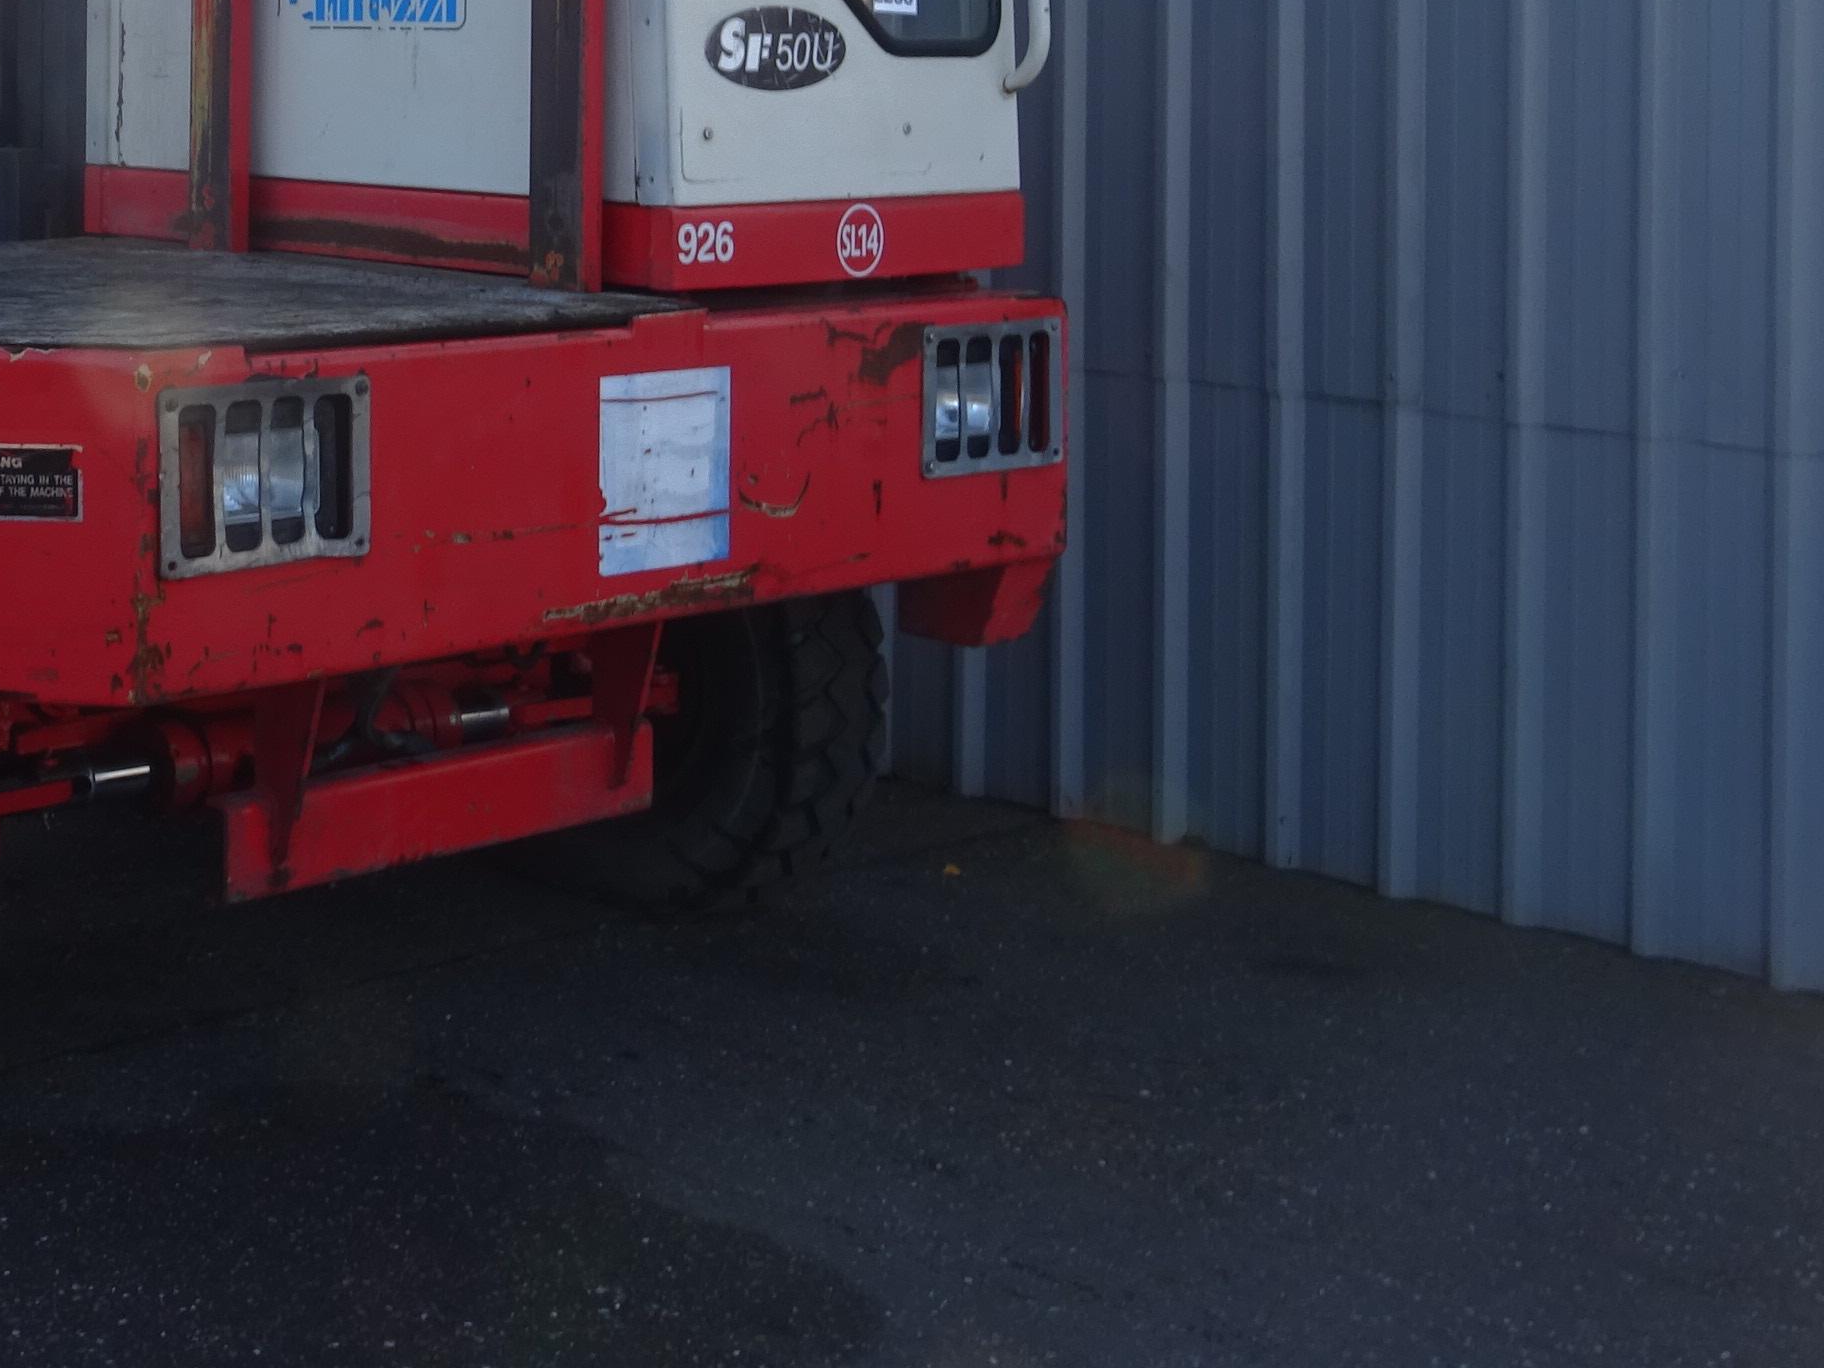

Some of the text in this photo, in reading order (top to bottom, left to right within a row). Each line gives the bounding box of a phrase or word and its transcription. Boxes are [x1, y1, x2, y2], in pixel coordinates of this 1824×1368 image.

[677, 220, 734, 265] 926
[841, 223, 878, 259] SL14
[39, 474, 50, 486] IN
[54, 474, 74, 486] THE
[9, 486, 27, 498] THE
[30, 486, 74, 499] MACHINE
